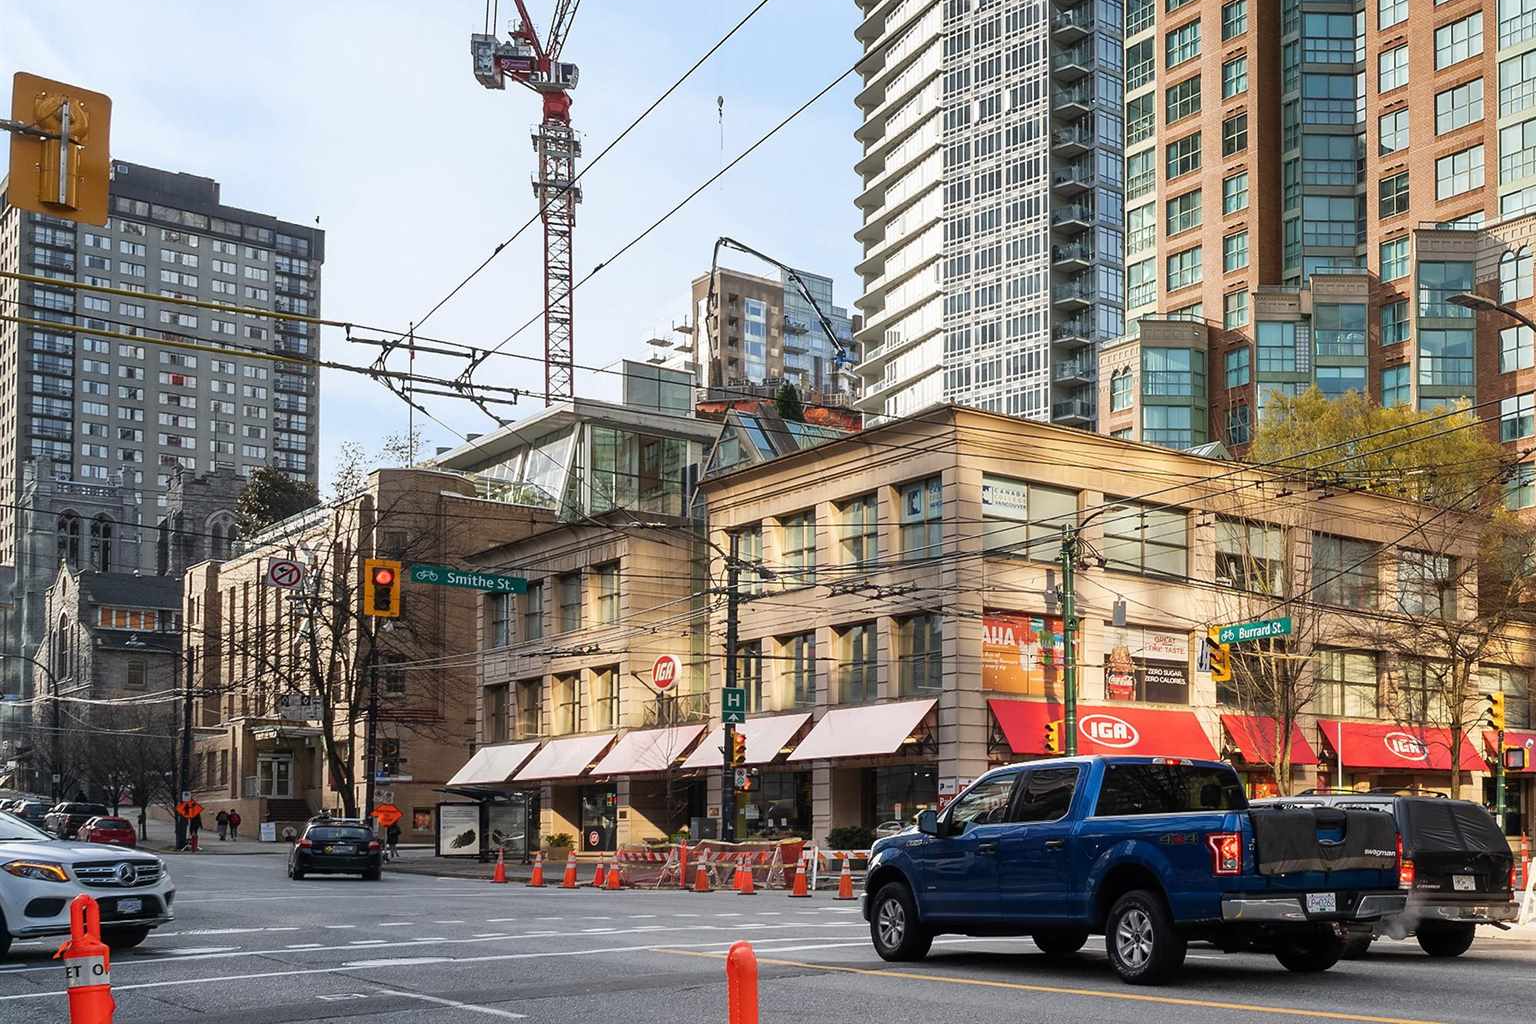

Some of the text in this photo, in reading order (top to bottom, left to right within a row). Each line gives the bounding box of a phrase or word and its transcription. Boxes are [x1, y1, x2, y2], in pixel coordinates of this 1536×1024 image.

[447, 572, 515, 590] Smithe St.
[1238, 622, 1285, 639] Burrard St.
[1148, 667, 1163, 676] ZERO
[1144, 675, 1160, 683] ZERO
[727, 693, 740, 707] H
